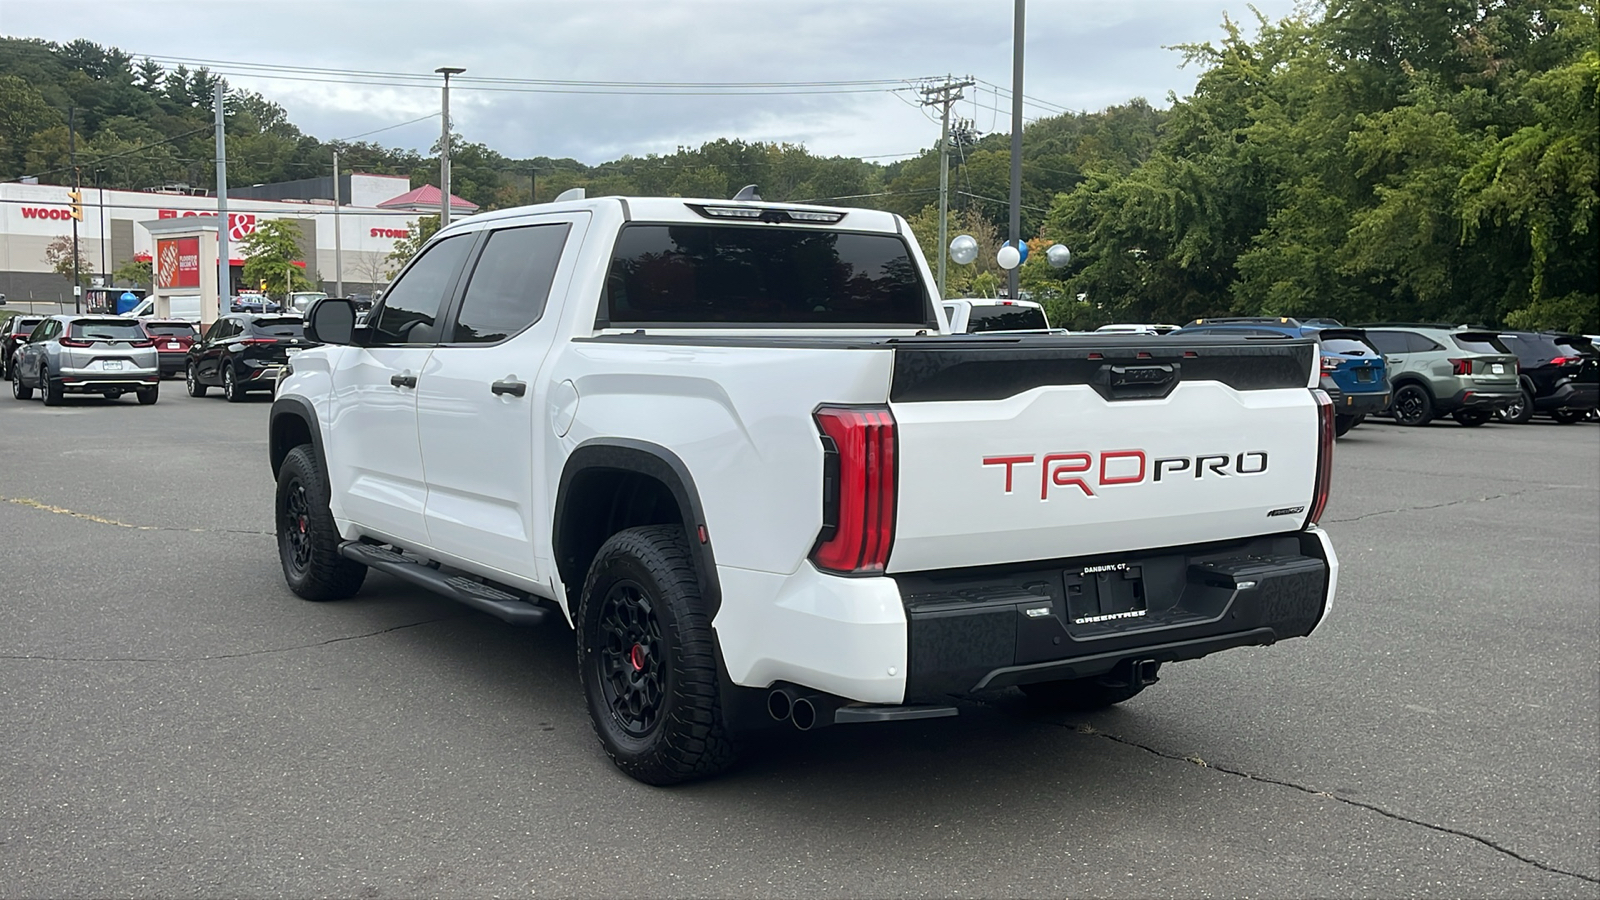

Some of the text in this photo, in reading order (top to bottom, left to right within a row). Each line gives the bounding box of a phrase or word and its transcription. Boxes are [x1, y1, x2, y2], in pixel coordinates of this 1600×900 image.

[21, 207, 72, 221] WOOD
[370, 228, 410, 239] STONE
[982, 448, 1269, 502] TRD PRO
[1084, 564, 1117, 574] DANBURY,
[1075, 610, 1146, 624] GREENTREE
